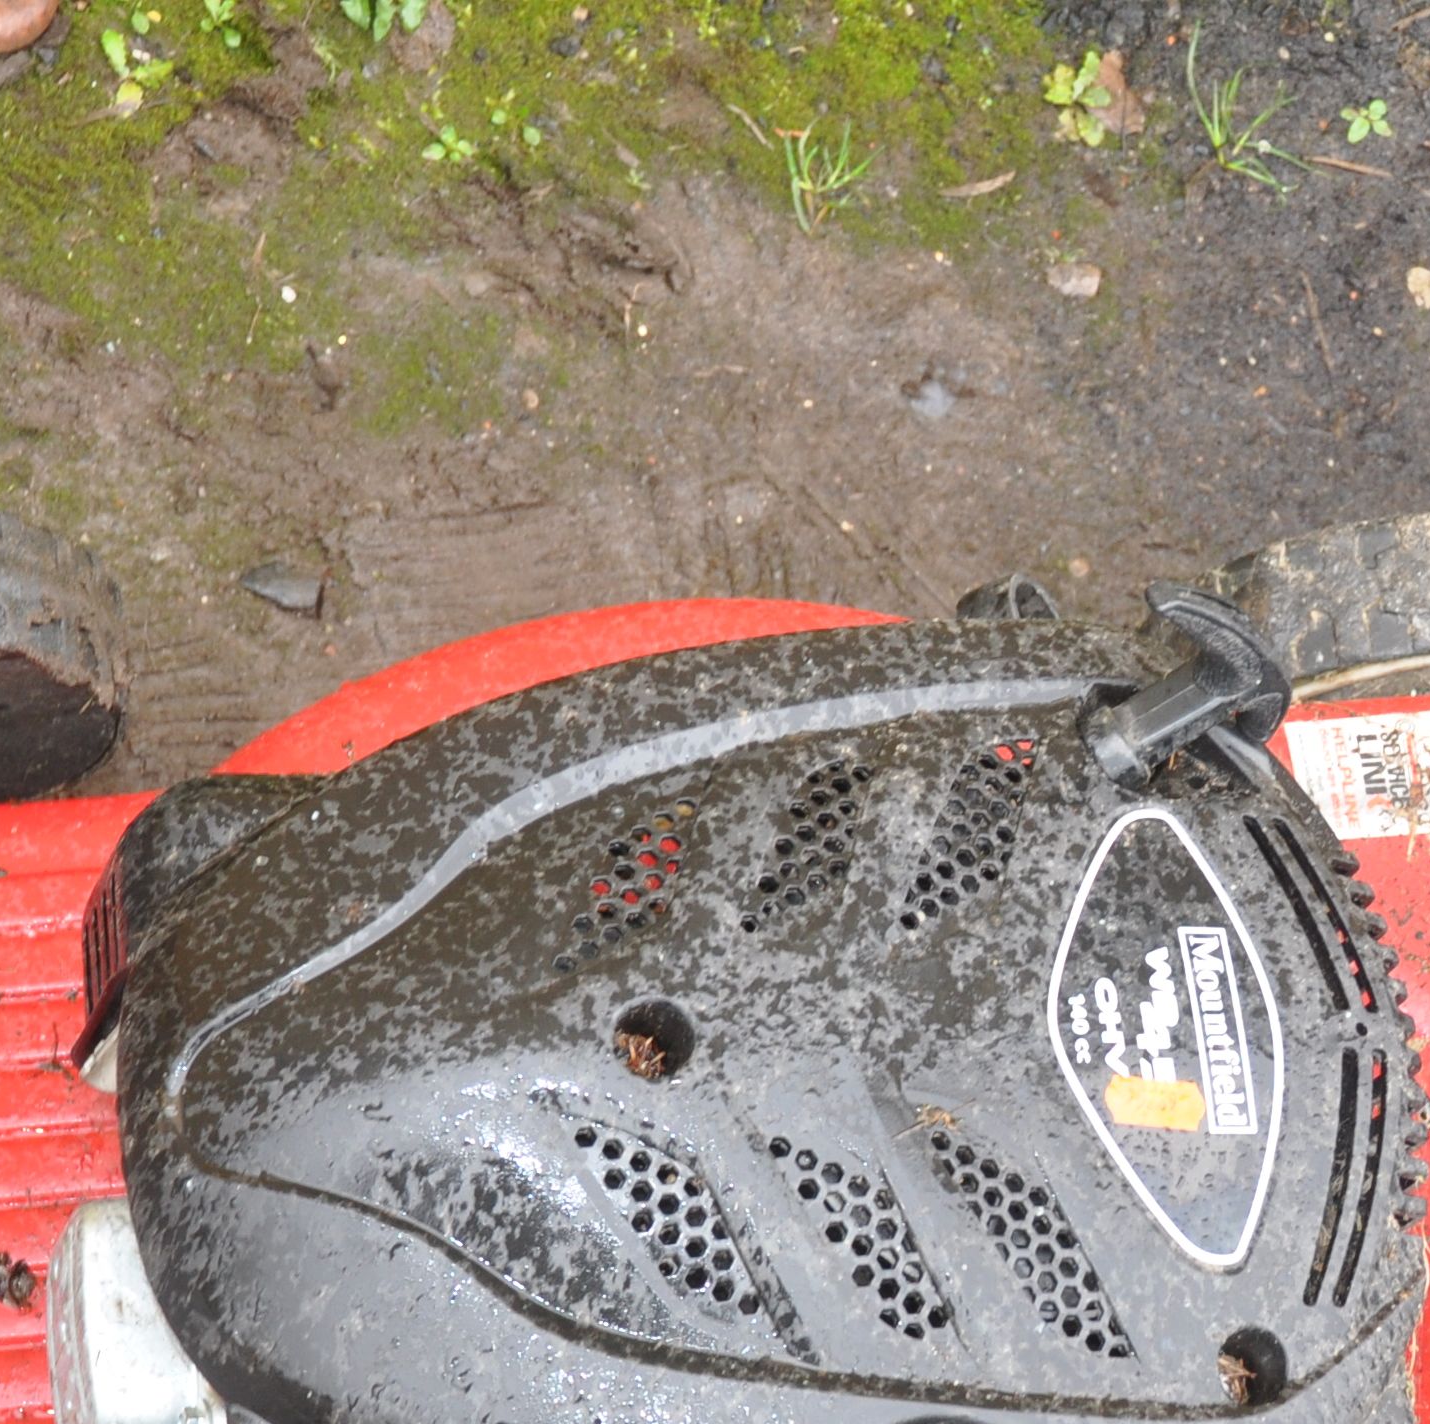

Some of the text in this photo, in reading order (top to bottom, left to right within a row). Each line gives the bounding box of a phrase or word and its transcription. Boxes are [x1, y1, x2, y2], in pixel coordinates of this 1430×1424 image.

[1380, 730, 1410, 810] SEVICE
[1068, 993, 1091, 1064] 140 cc
[1094, 976, 1130, 1078] OHV
[1188, 935, 1248, 1126] Mountfield
